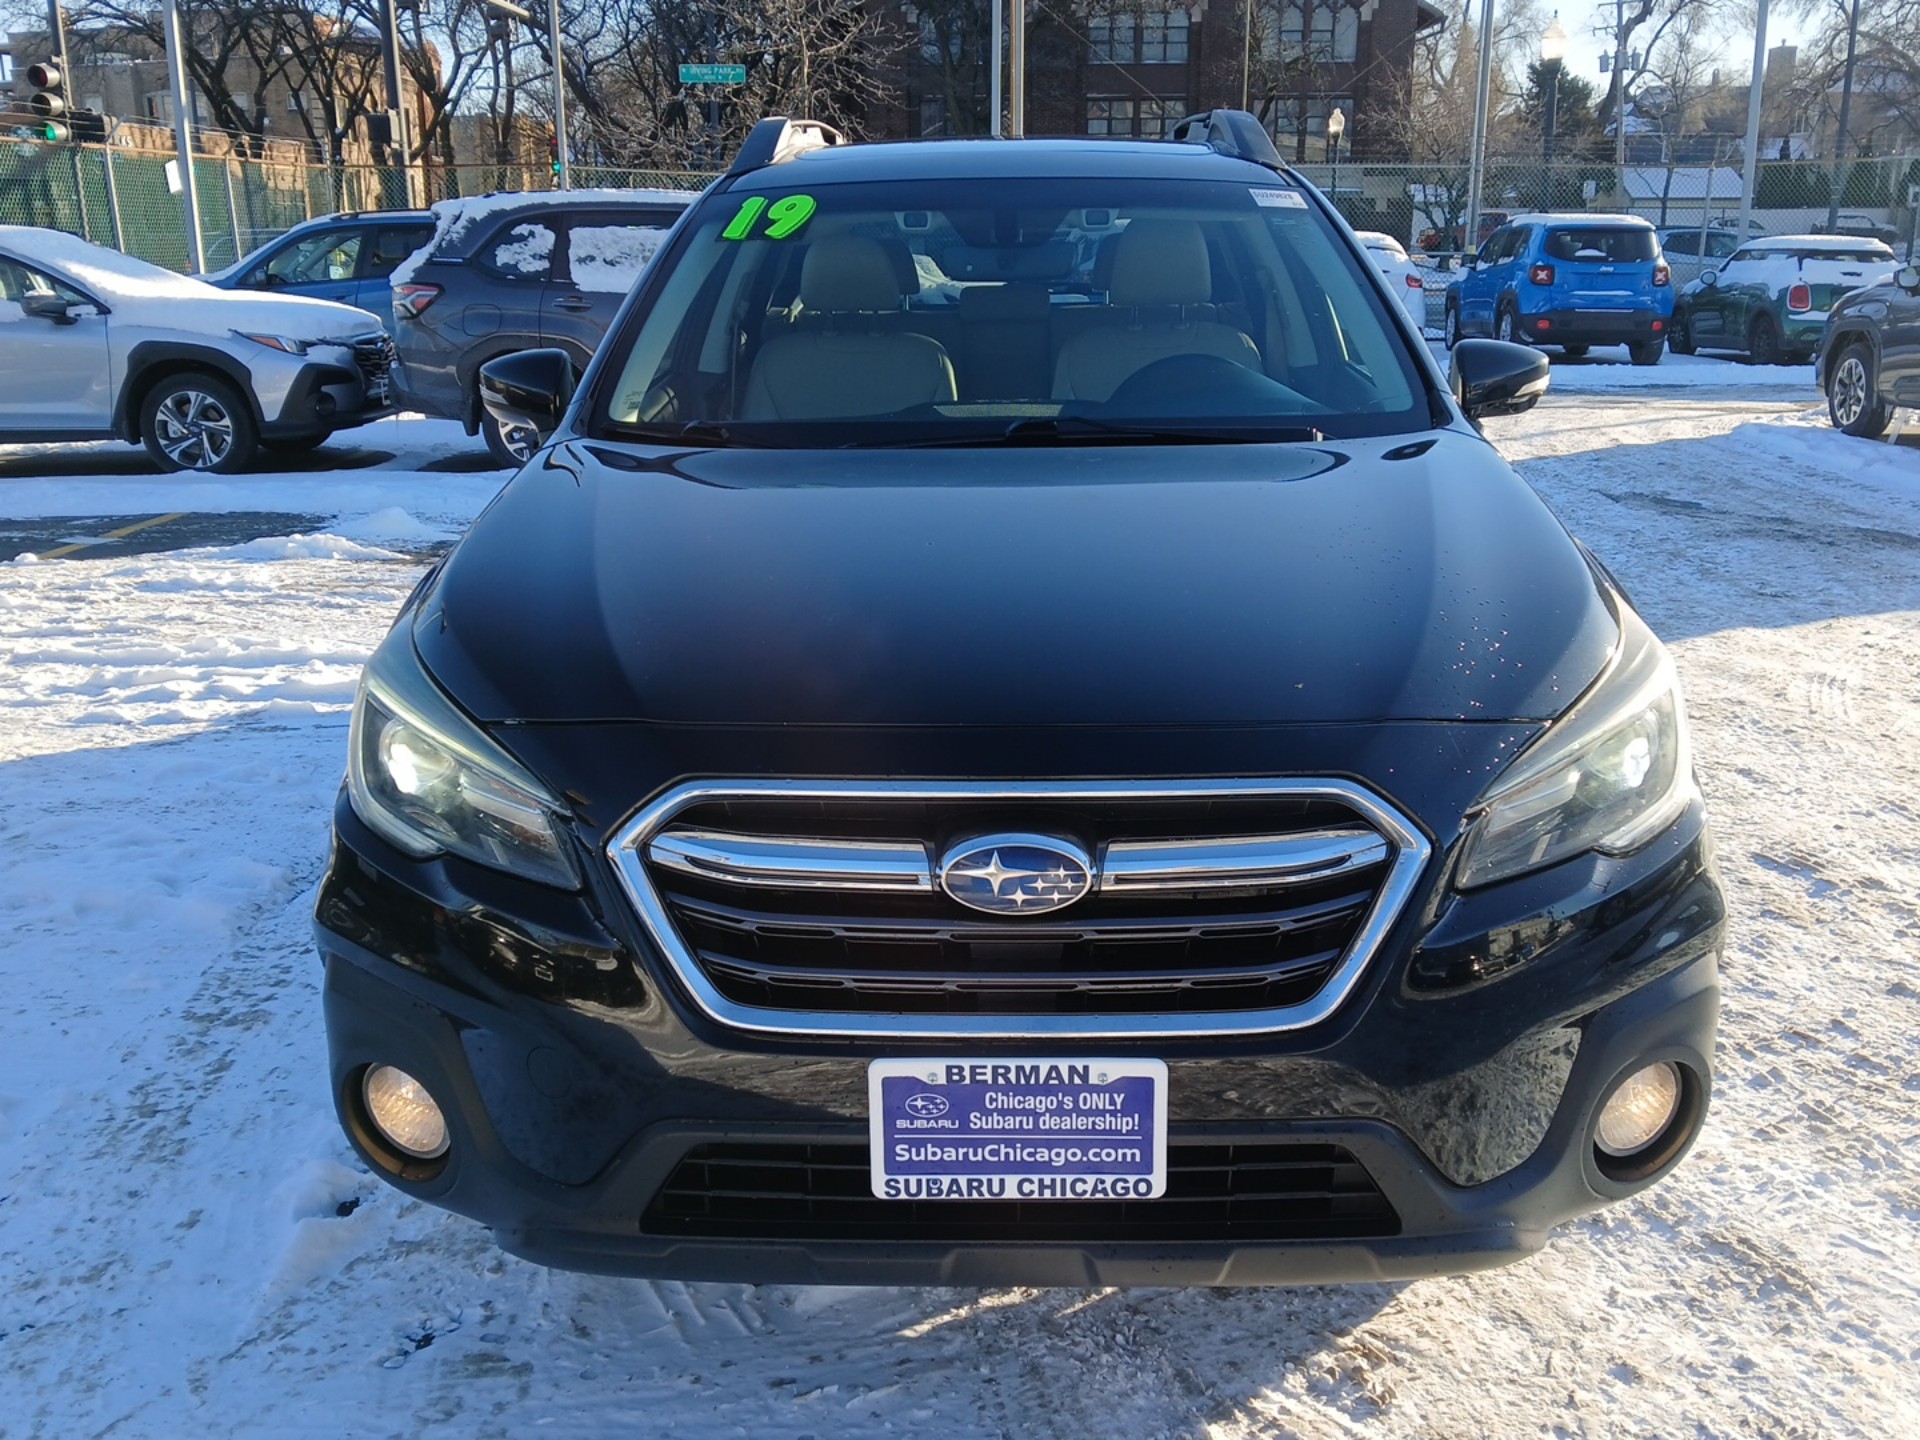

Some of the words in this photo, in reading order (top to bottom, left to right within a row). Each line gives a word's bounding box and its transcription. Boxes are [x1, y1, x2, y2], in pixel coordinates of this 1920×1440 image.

[722, 194, 817, 240] 19
[945, 1064, 1091, 1085] BERMAN
[985, 1092, 1073, 1112] Chicago's
[1078, 1093, 1125, 1110] ONLY
[896, 1119, 959, 1129] SUBARU
[969, 1112, 1033, 1130] Subaru
[1039, 1113, 1139, 1133] dealership!
[895, 1144, 1141, 1166] SubaruChicago.com
[884, 1178, 1005, 1198] SUBARU
[1016, 1178, 1154, 1198] CHICAGO
